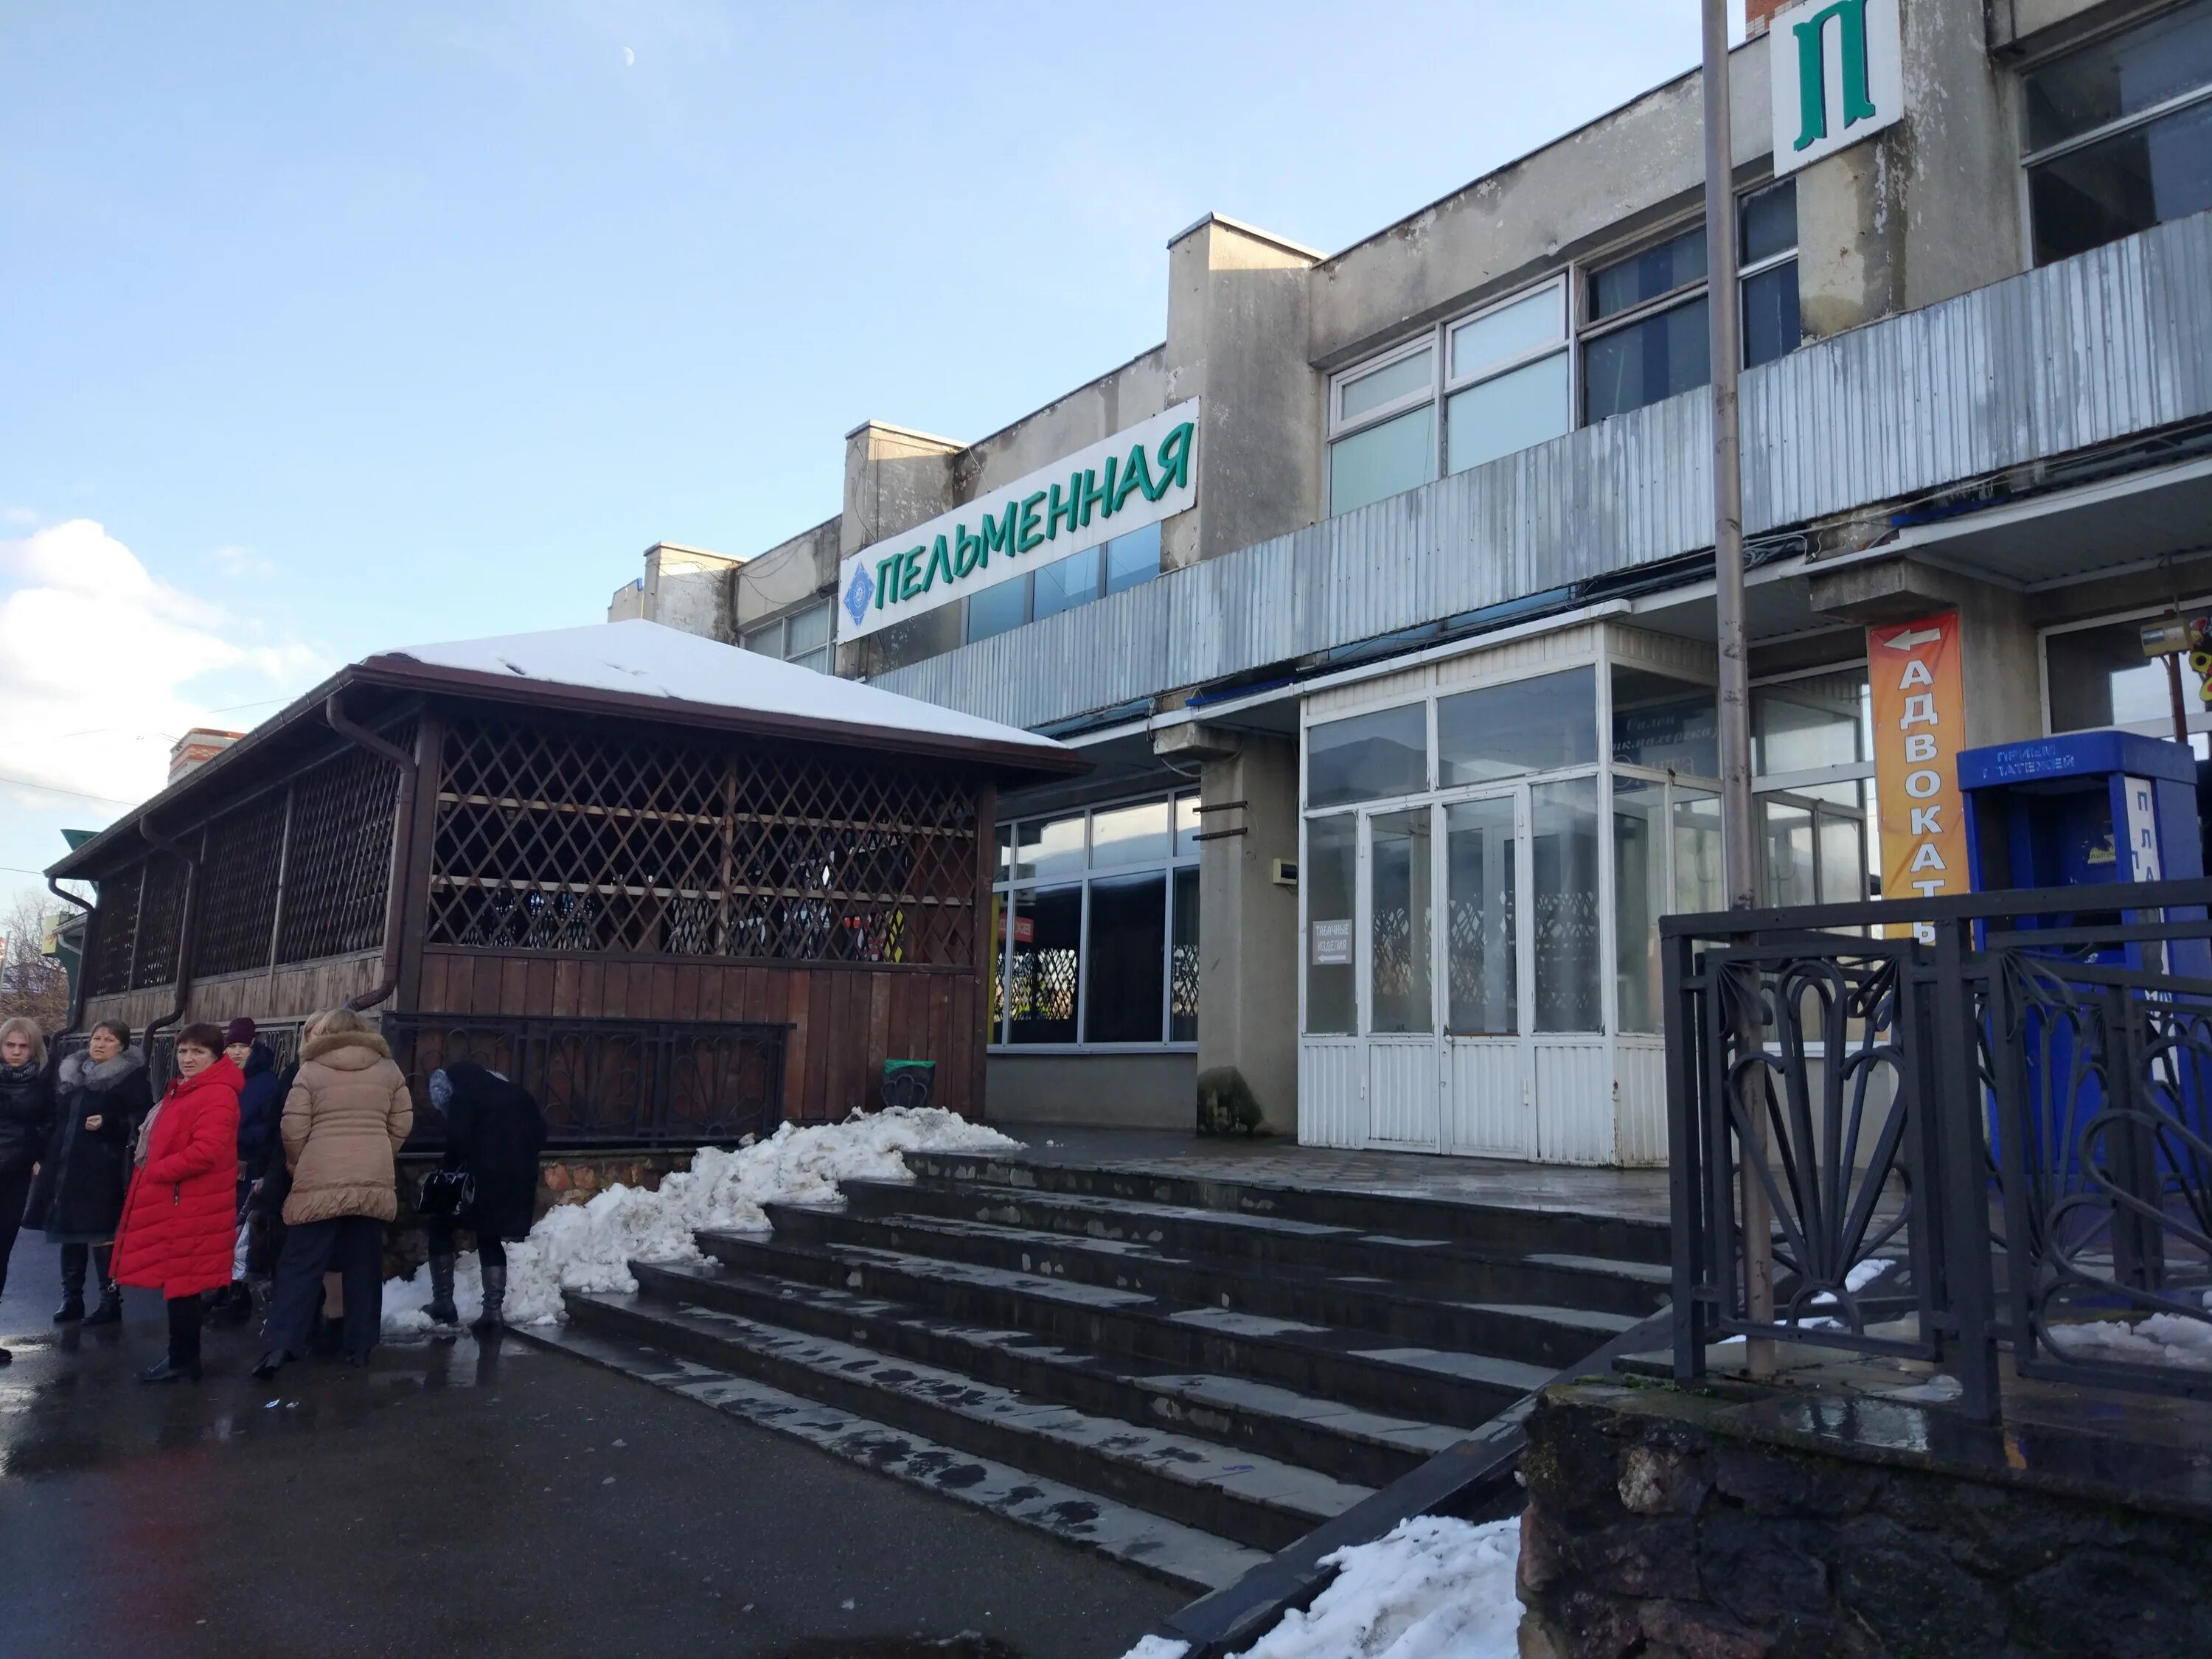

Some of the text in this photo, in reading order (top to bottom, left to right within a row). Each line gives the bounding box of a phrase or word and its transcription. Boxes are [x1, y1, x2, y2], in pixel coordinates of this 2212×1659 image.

[1792, 0, 1876, 152] П
[875, 422, 1194, 610] ПЕЛЬМЕННАЯ
[1315, 923, 1349, 937] ТАБАЧНЫЕ
[1318, 939, 1347, 953] ИЗДЕЛИЯ
